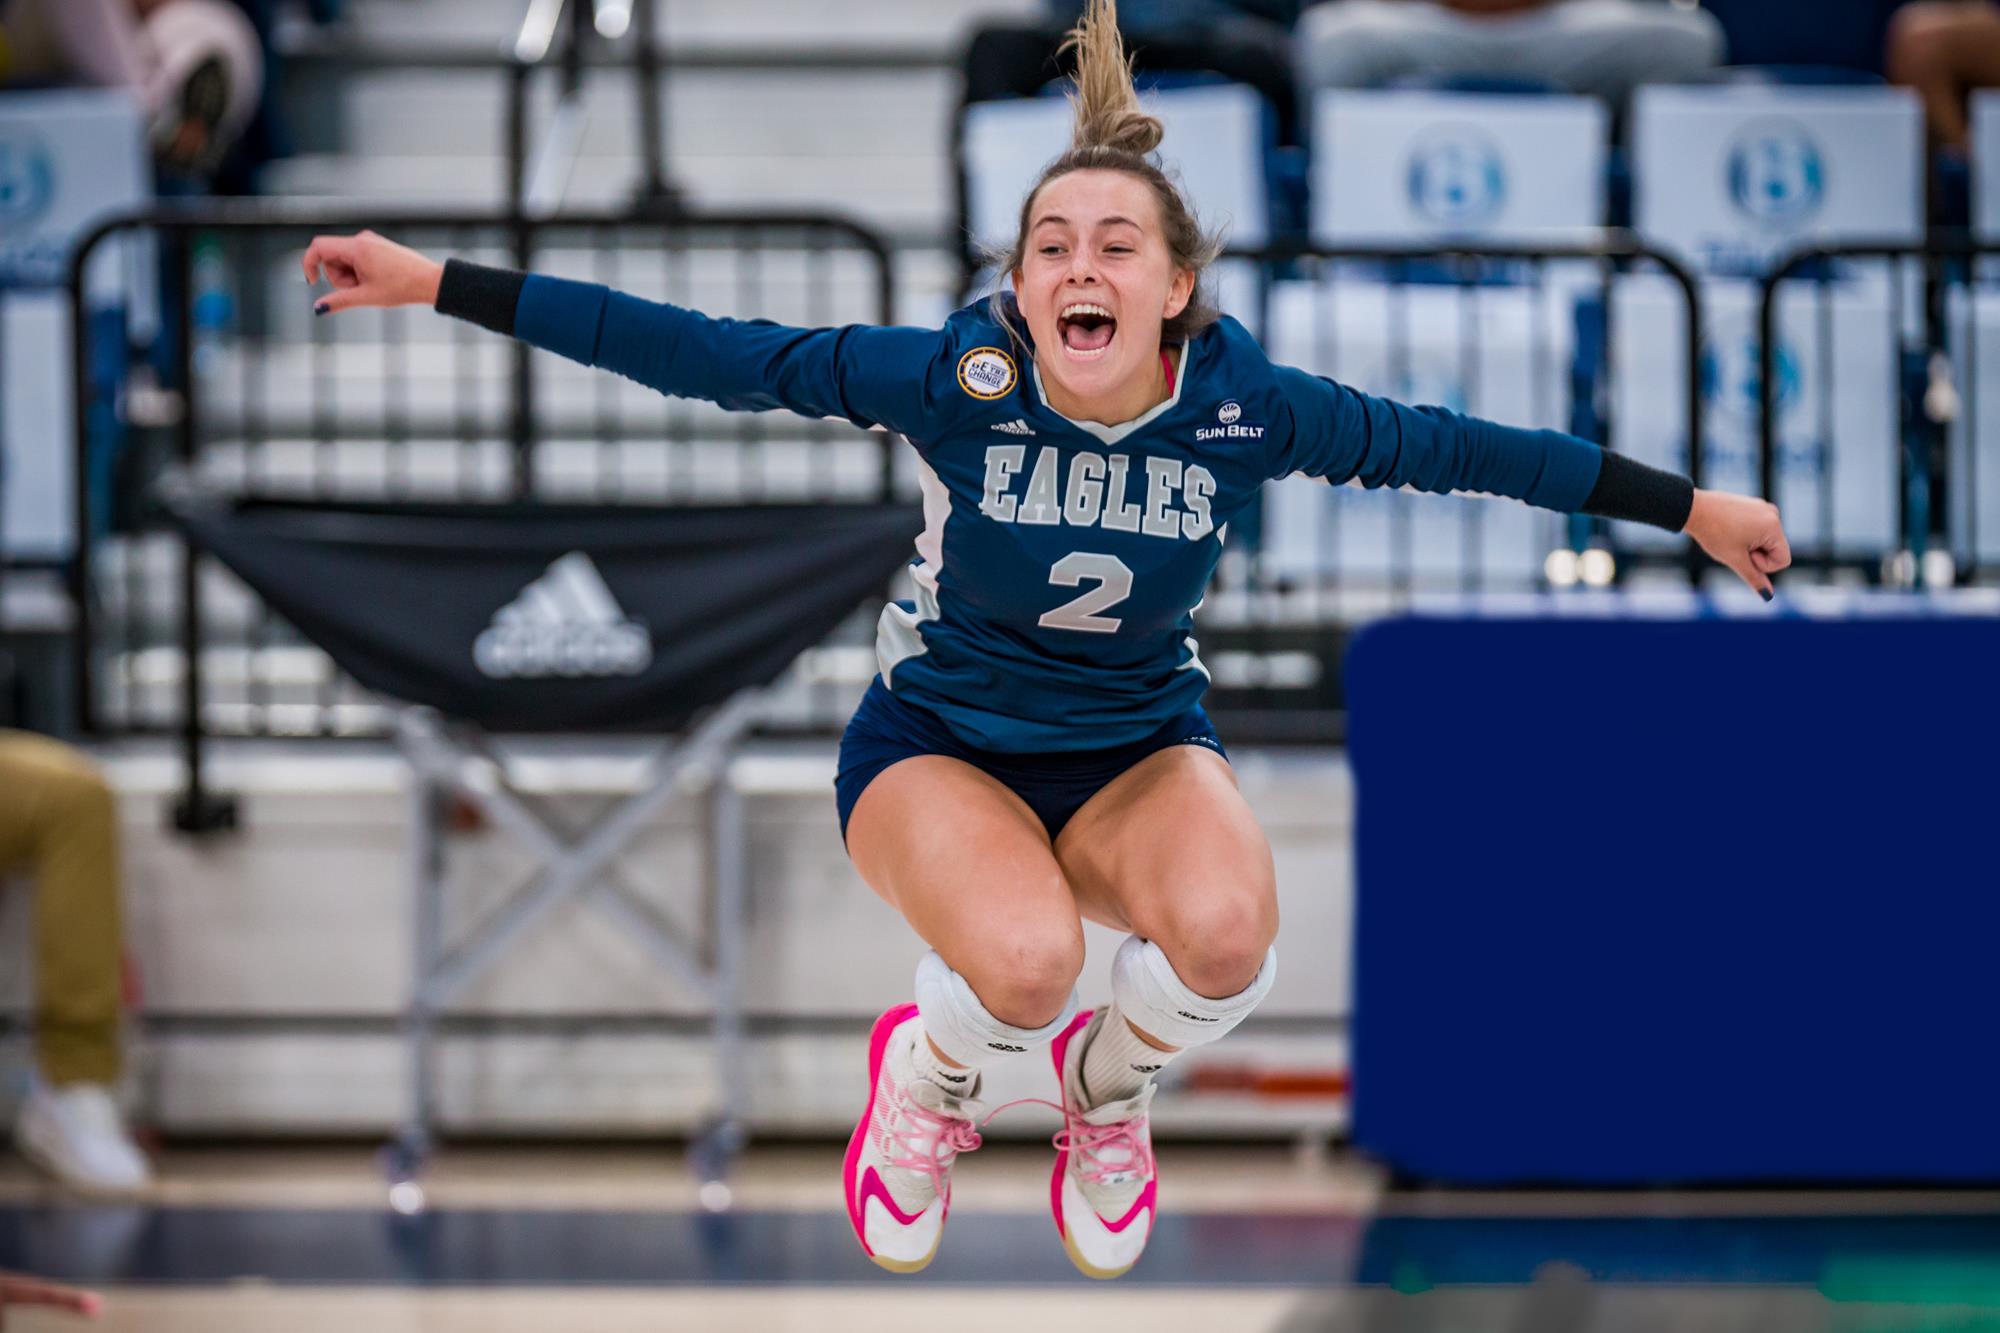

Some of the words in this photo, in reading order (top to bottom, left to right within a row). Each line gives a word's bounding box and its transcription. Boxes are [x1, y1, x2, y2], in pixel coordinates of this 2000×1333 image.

[971, 359, 990, 372] BE
[968, 368, 1002, 386] CHANGE
[1195, 427, 1226, 441] SUN
[1227, 424, 1265, 439] BELT
[978, 444, 1217, 542] EAGLES
[1037, 550, 1135, 634] 2
